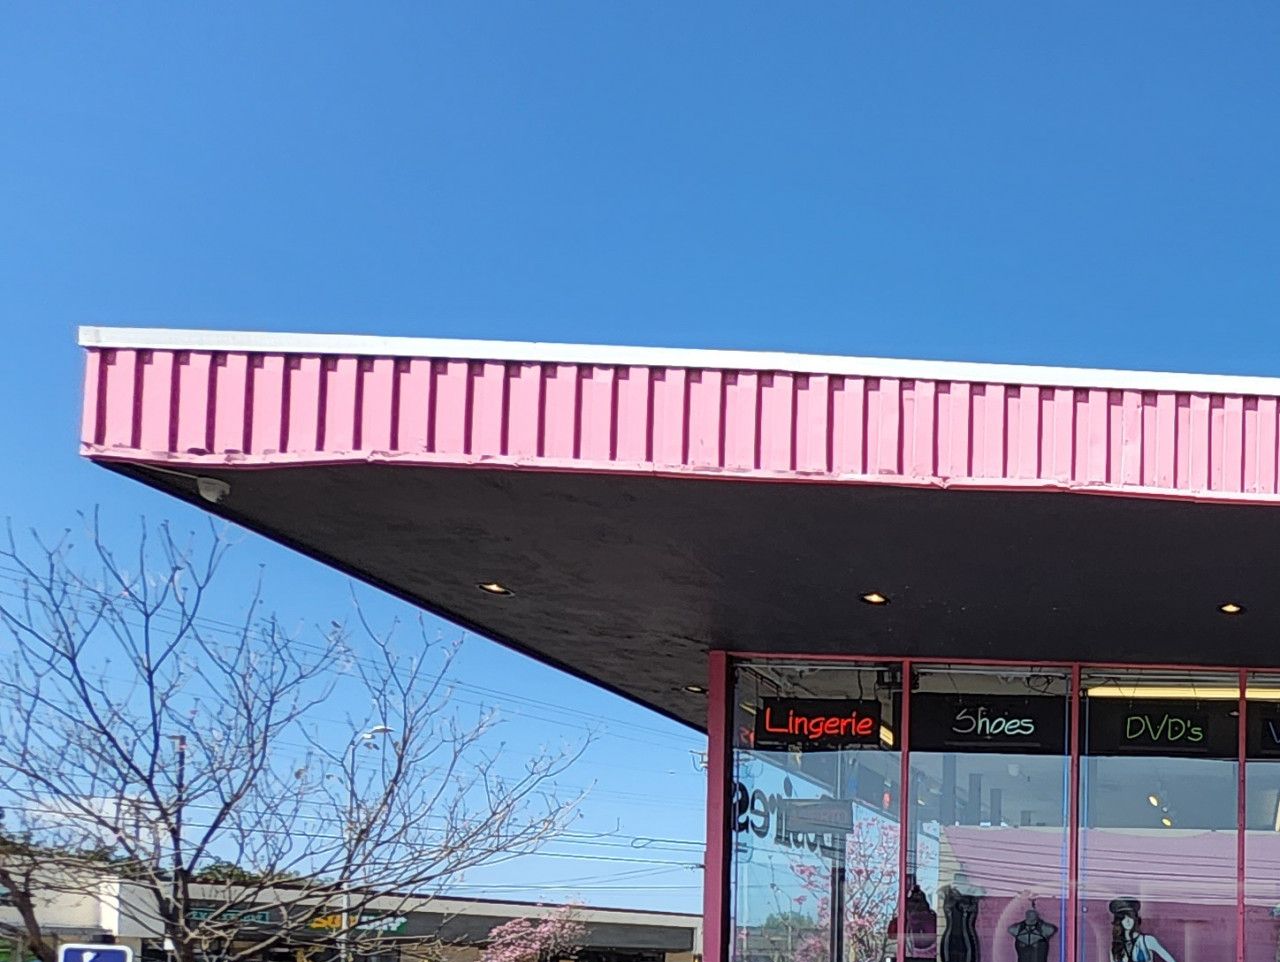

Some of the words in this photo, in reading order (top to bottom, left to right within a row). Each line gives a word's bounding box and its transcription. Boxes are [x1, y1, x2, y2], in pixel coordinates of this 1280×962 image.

[765, 707, 873, 739] Lingerie
[952, 706, 1034, 735] Shoes
[1126, 713, 1203, 741] DVD's
